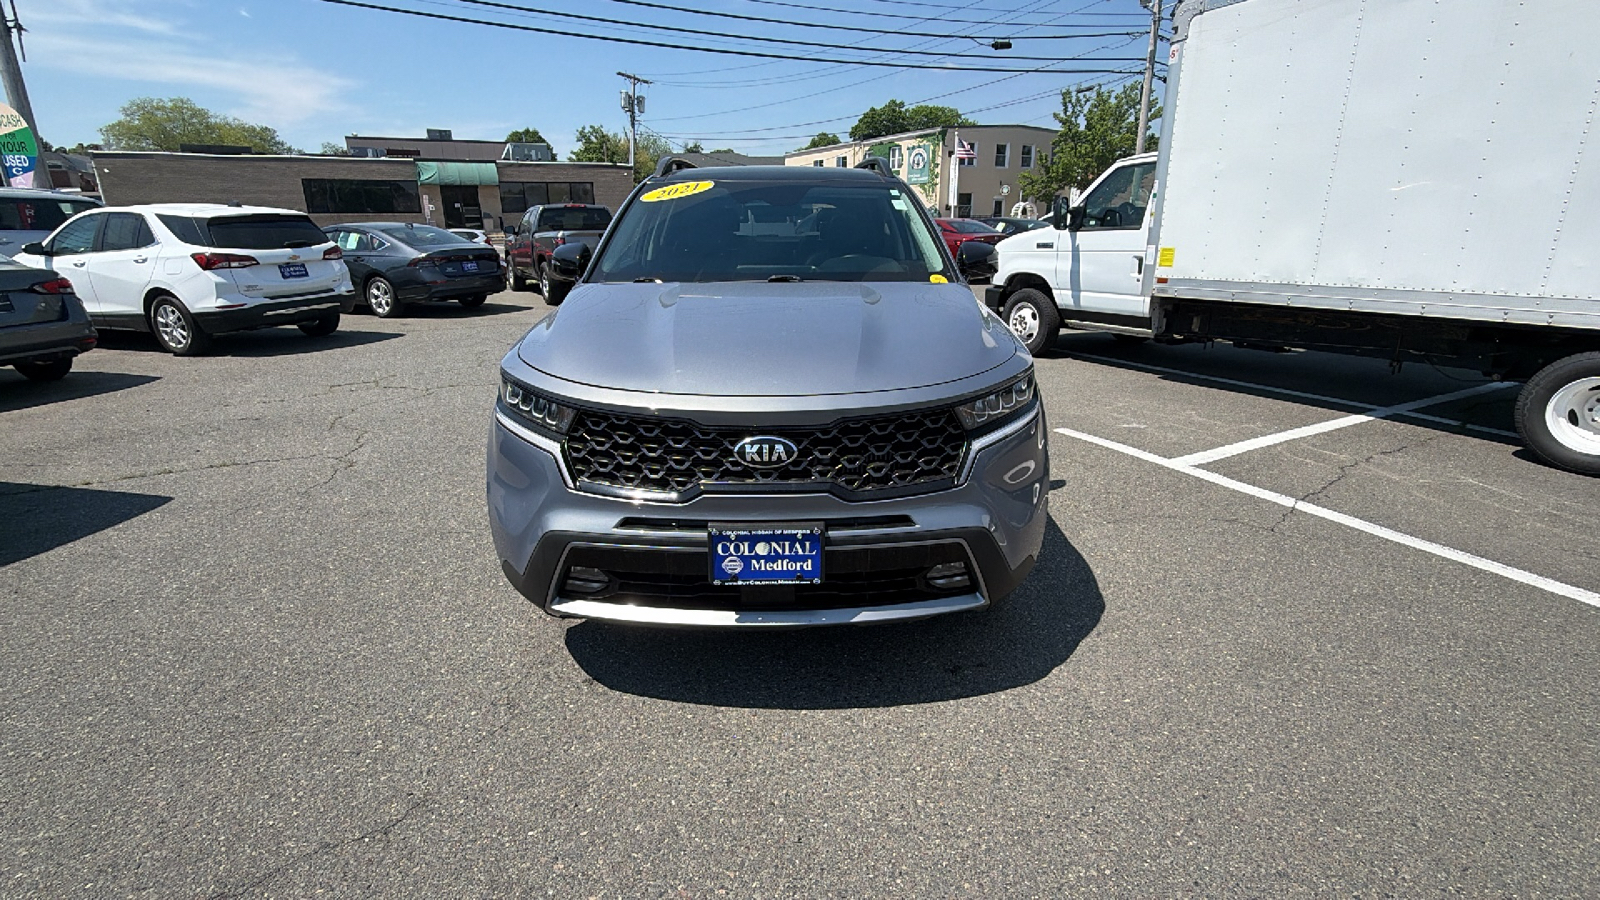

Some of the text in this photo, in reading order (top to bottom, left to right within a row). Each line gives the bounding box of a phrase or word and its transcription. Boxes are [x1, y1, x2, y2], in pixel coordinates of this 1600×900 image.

[5, 132, 17, 140] FOR
[0, 141, 28, 153] YOUR
[3, 154, 29, 167] USED
[656, 183, 700, 199] 2021
[744, 444, 788, 462] KIA
[717, 541, 817, 556] COLONIAL
[751, 559, 812, 571] Medford
